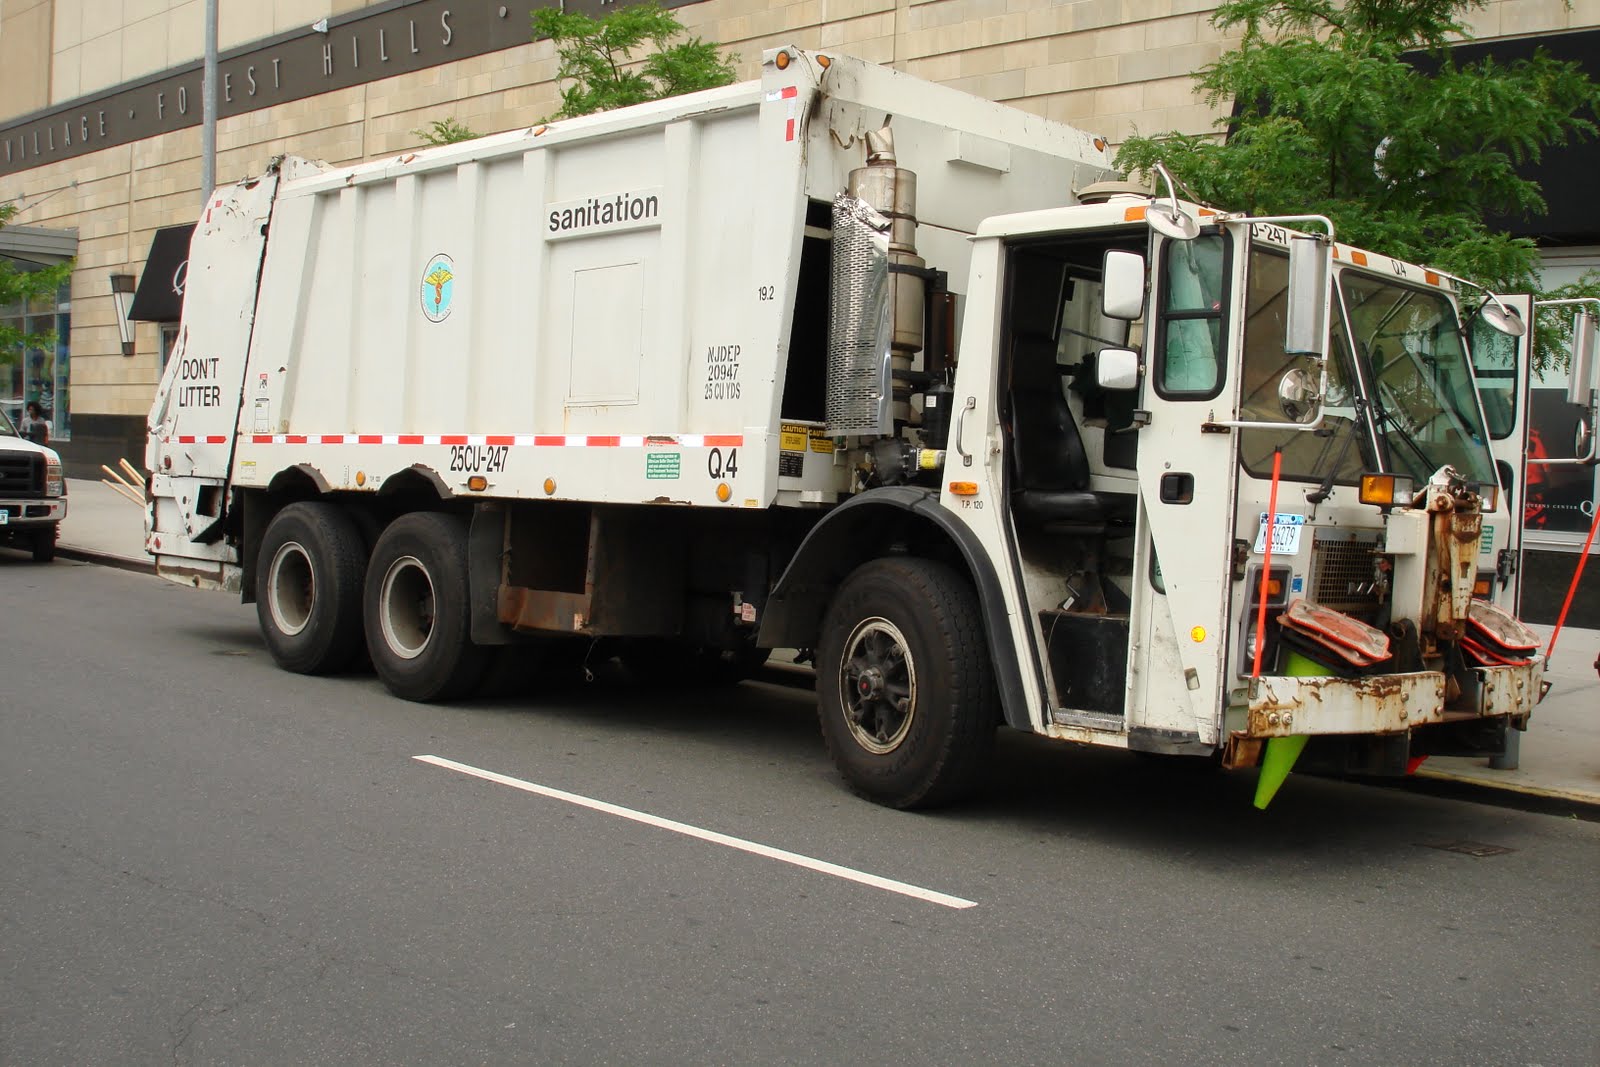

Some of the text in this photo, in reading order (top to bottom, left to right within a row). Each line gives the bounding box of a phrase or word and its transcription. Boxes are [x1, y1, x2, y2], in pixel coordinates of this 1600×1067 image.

[6, 10, 452, 163] VILLAGE FOEST HILLS
[549, 192, 659, 232] sanitation
[707, 345, 741, 363] NJDEP
[182, 357, 220, 380] DON'T
[708, 363, 740, 381] 20947
[179, 385, 221, 407] LITTER
[781, 425, 807, 434] CAUTION
[450, 444, 509, 472] 25CU-247
[708, 447, 738, 479] Q.4
